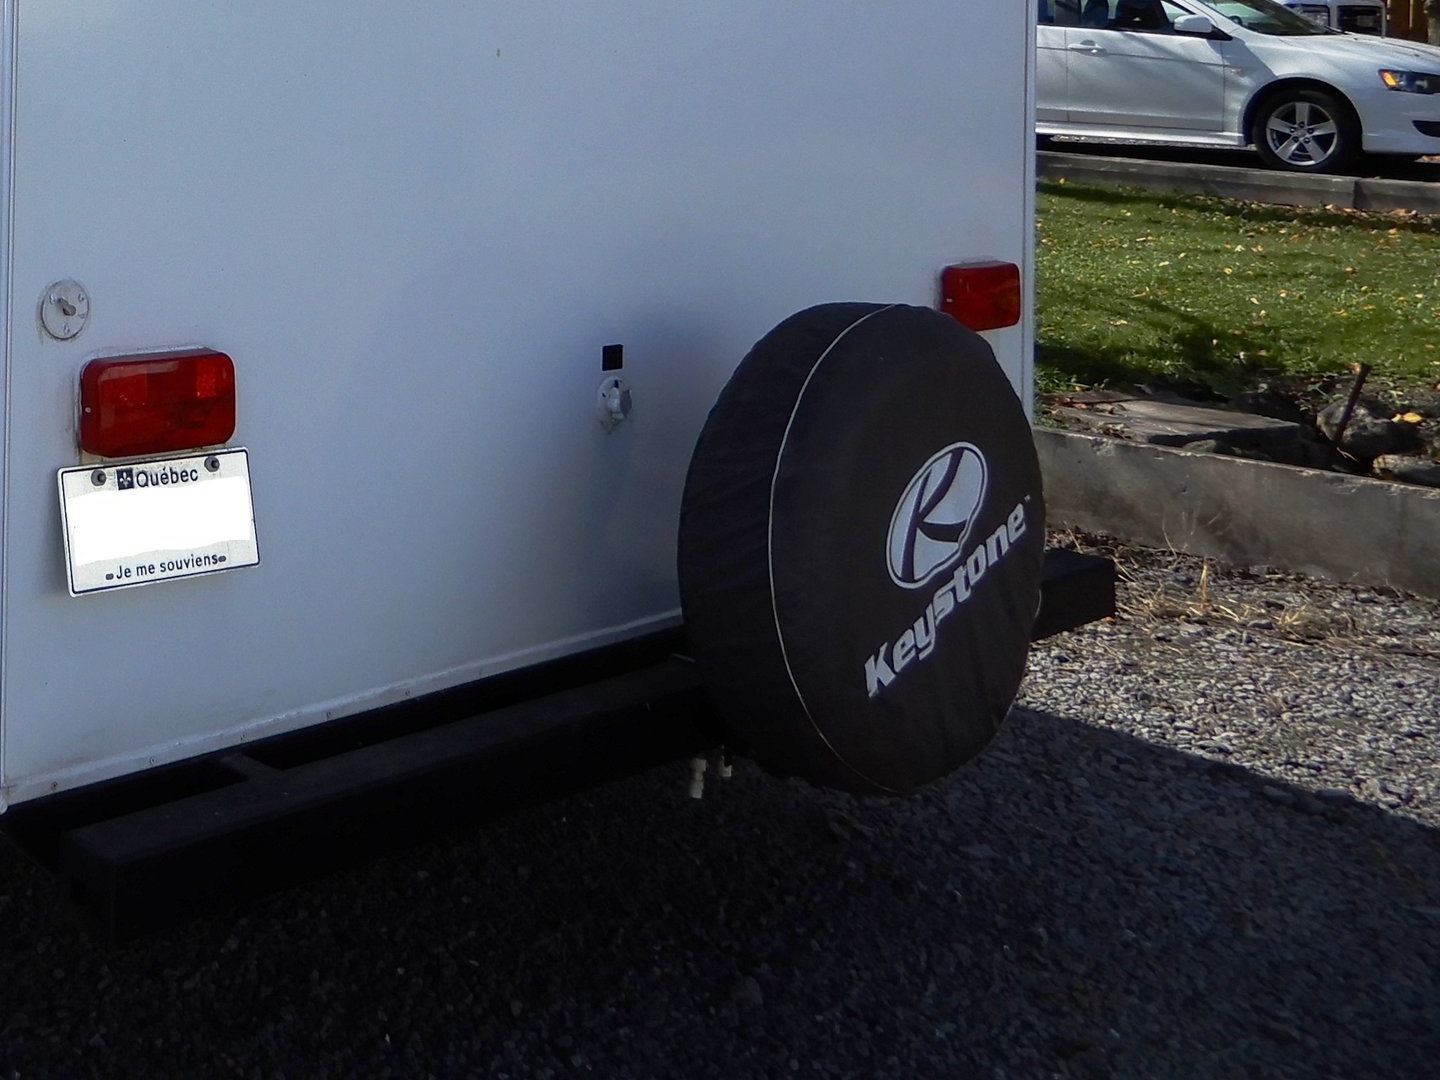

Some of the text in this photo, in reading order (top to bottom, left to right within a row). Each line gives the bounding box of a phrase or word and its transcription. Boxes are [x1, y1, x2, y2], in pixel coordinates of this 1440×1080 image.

[136, 466, 199, 488] Québec
[116, 553, 218, 580] Je me souviens
[864, 502, 1027, 699] Keystone
